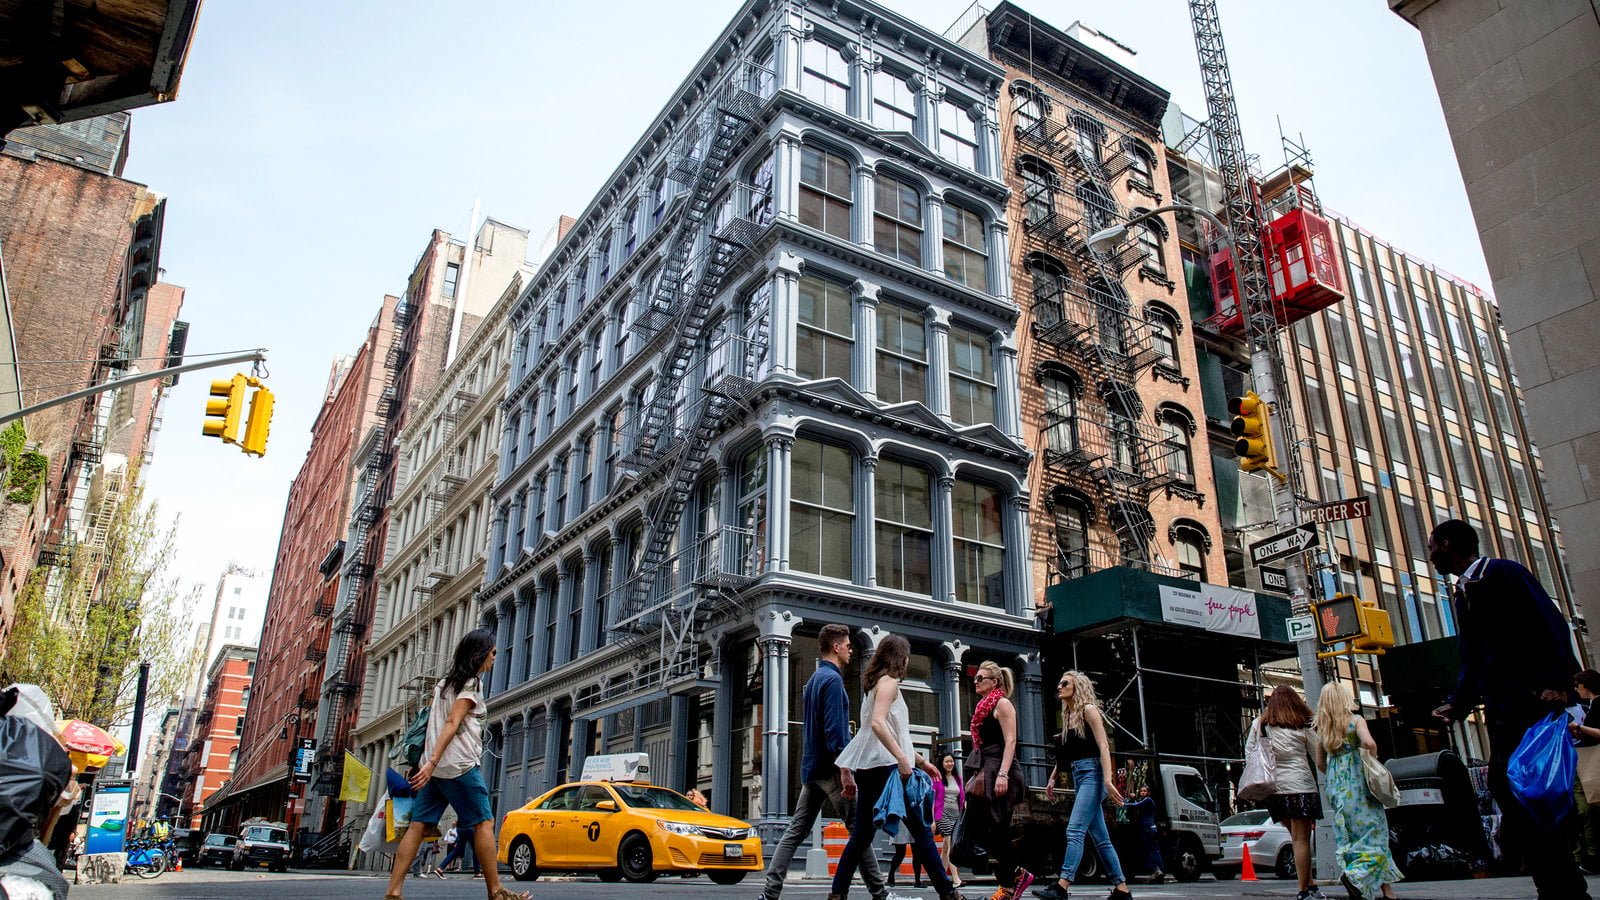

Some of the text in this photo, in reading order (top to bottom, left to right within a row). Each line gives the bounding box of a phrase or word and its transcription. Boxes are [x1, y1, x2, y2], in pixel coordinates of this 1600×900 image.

[1302, 501, 1368, 523] MERCER ST
[1260, 532, 1307, 557] ONE WAY
[1268, 574, 1286, 586] ONE
[1205, 597, 1226, 615] free
[1228, 604, 1256, 623] people
[1291, 622, 1303, 636] P
